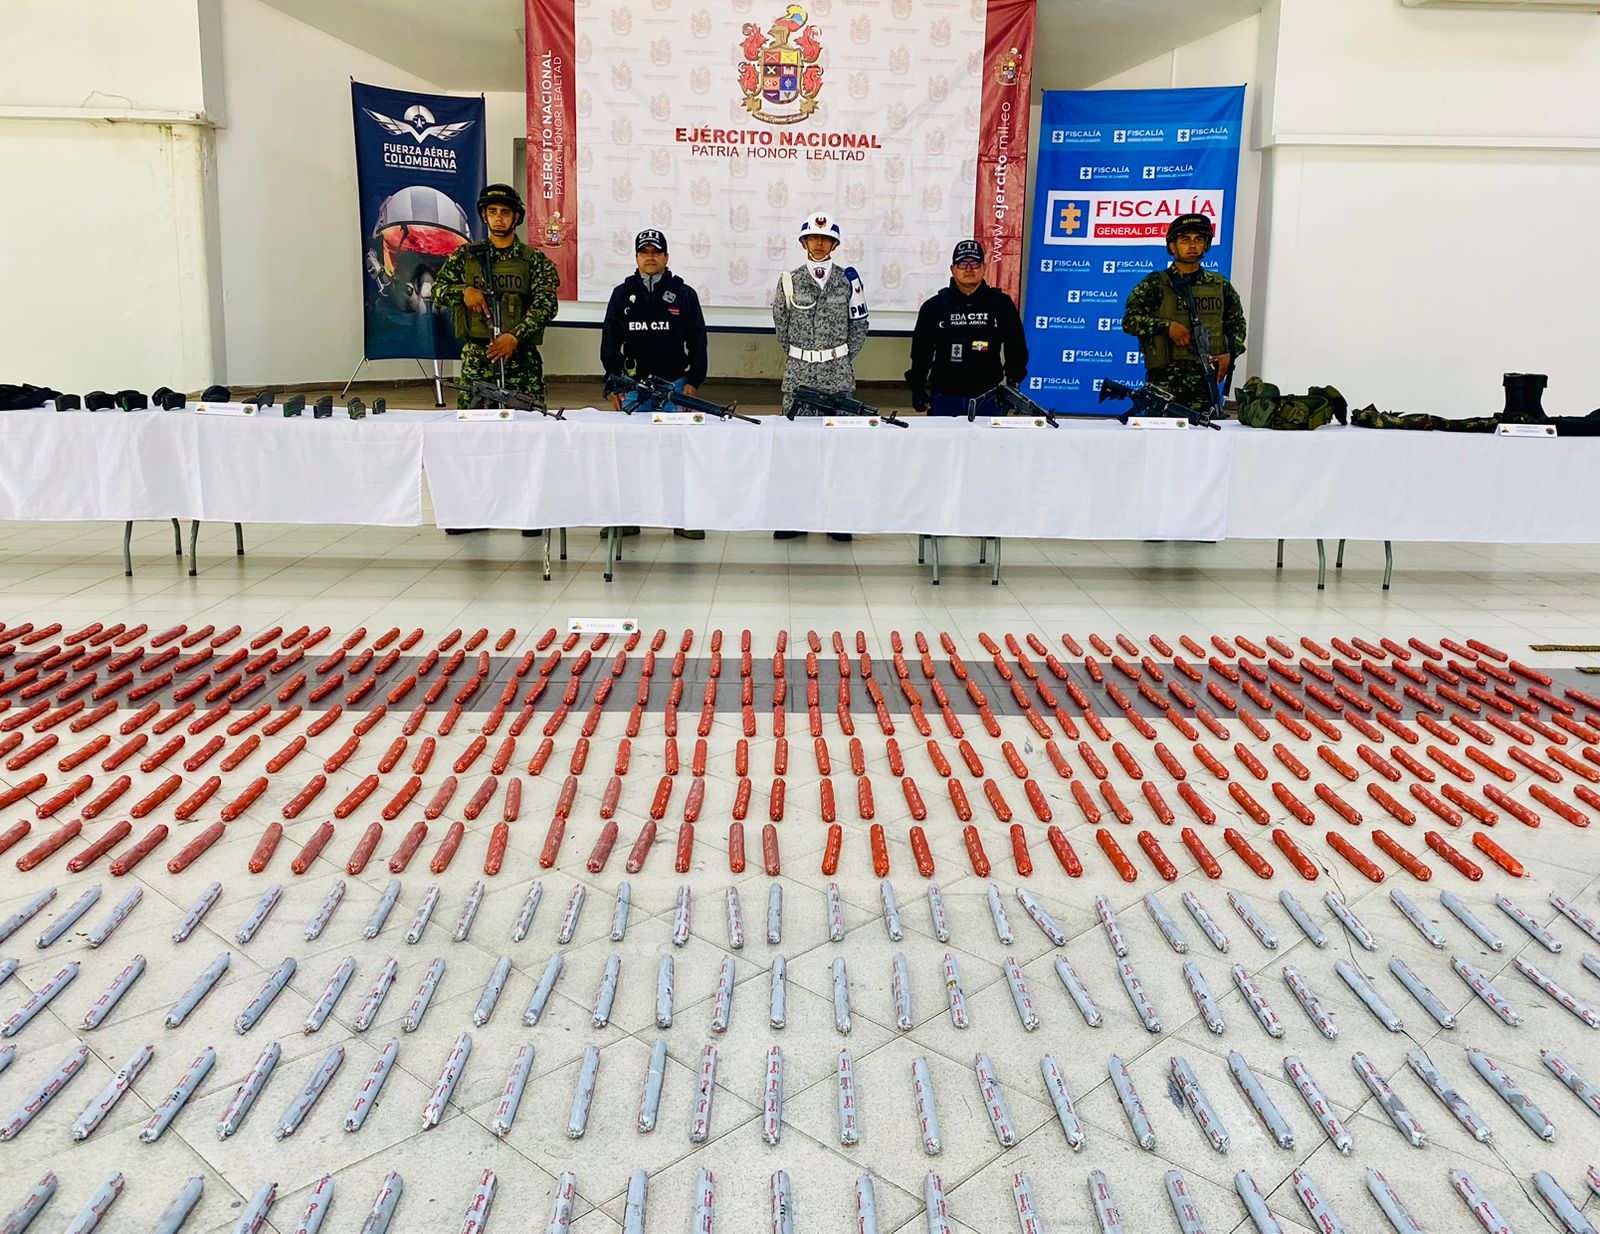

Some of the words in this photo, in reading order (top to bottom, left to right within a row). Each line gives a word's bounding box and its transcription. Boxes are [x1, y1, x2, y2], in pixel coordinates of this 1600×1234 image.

[553, 57, 562, 107] LEALTAD
[542, 49, 552, 125] NACIONAL
[1065, 129, 1101, 137] FISCALÍA
[1127, 128, 1164, 137] FISCALÍA
[1191, 126, 1228, 135] FISCALÍA
[675, 125, 773, 145] EJÉRCITO
[780, 131, 882, 149] NACIONAL
[384, 143, 422, 156] FUERZA
[424, 146, 456, 159] AÉREA
[691, 145, 740, 157] PATRIA
[747, 147, 798, 160] HONOR
[806, 150, 865, 161] LEALTAD
[384, 153, 457, 169] COLOMBIANA
[541, 128, 553, 199] EJÉRCITO
[1093, 165, 1130, 173] FISCALÍA
[1156, 163, 1194, 173] FISCALÍA
[554, 157, 563, 195] PATRIA
[1096, 195, 1216, 217] FISCALÍA
[1097, 226, 1142, 235] GENERAL
[1145, 226, 1159, 235] DE
[958, 241, 978, 250] CTI
[1054, 259, 1091, 267] FISCALÍA
[1116, 259, 1154, 268] FISCALÍA
[1081, 289, 1118, 297] FISCALÍA
[950, 313, 967, 321] EDA
[967, 312, 989, 321] CTI
[1049, 316, 1086, 324] FISCALÍA
[628, 321, 649, 331] EDA
[1076, 350, 1113, 358] FISCALÍA
[1043, 377, 1080, 385] FISCALÍA
